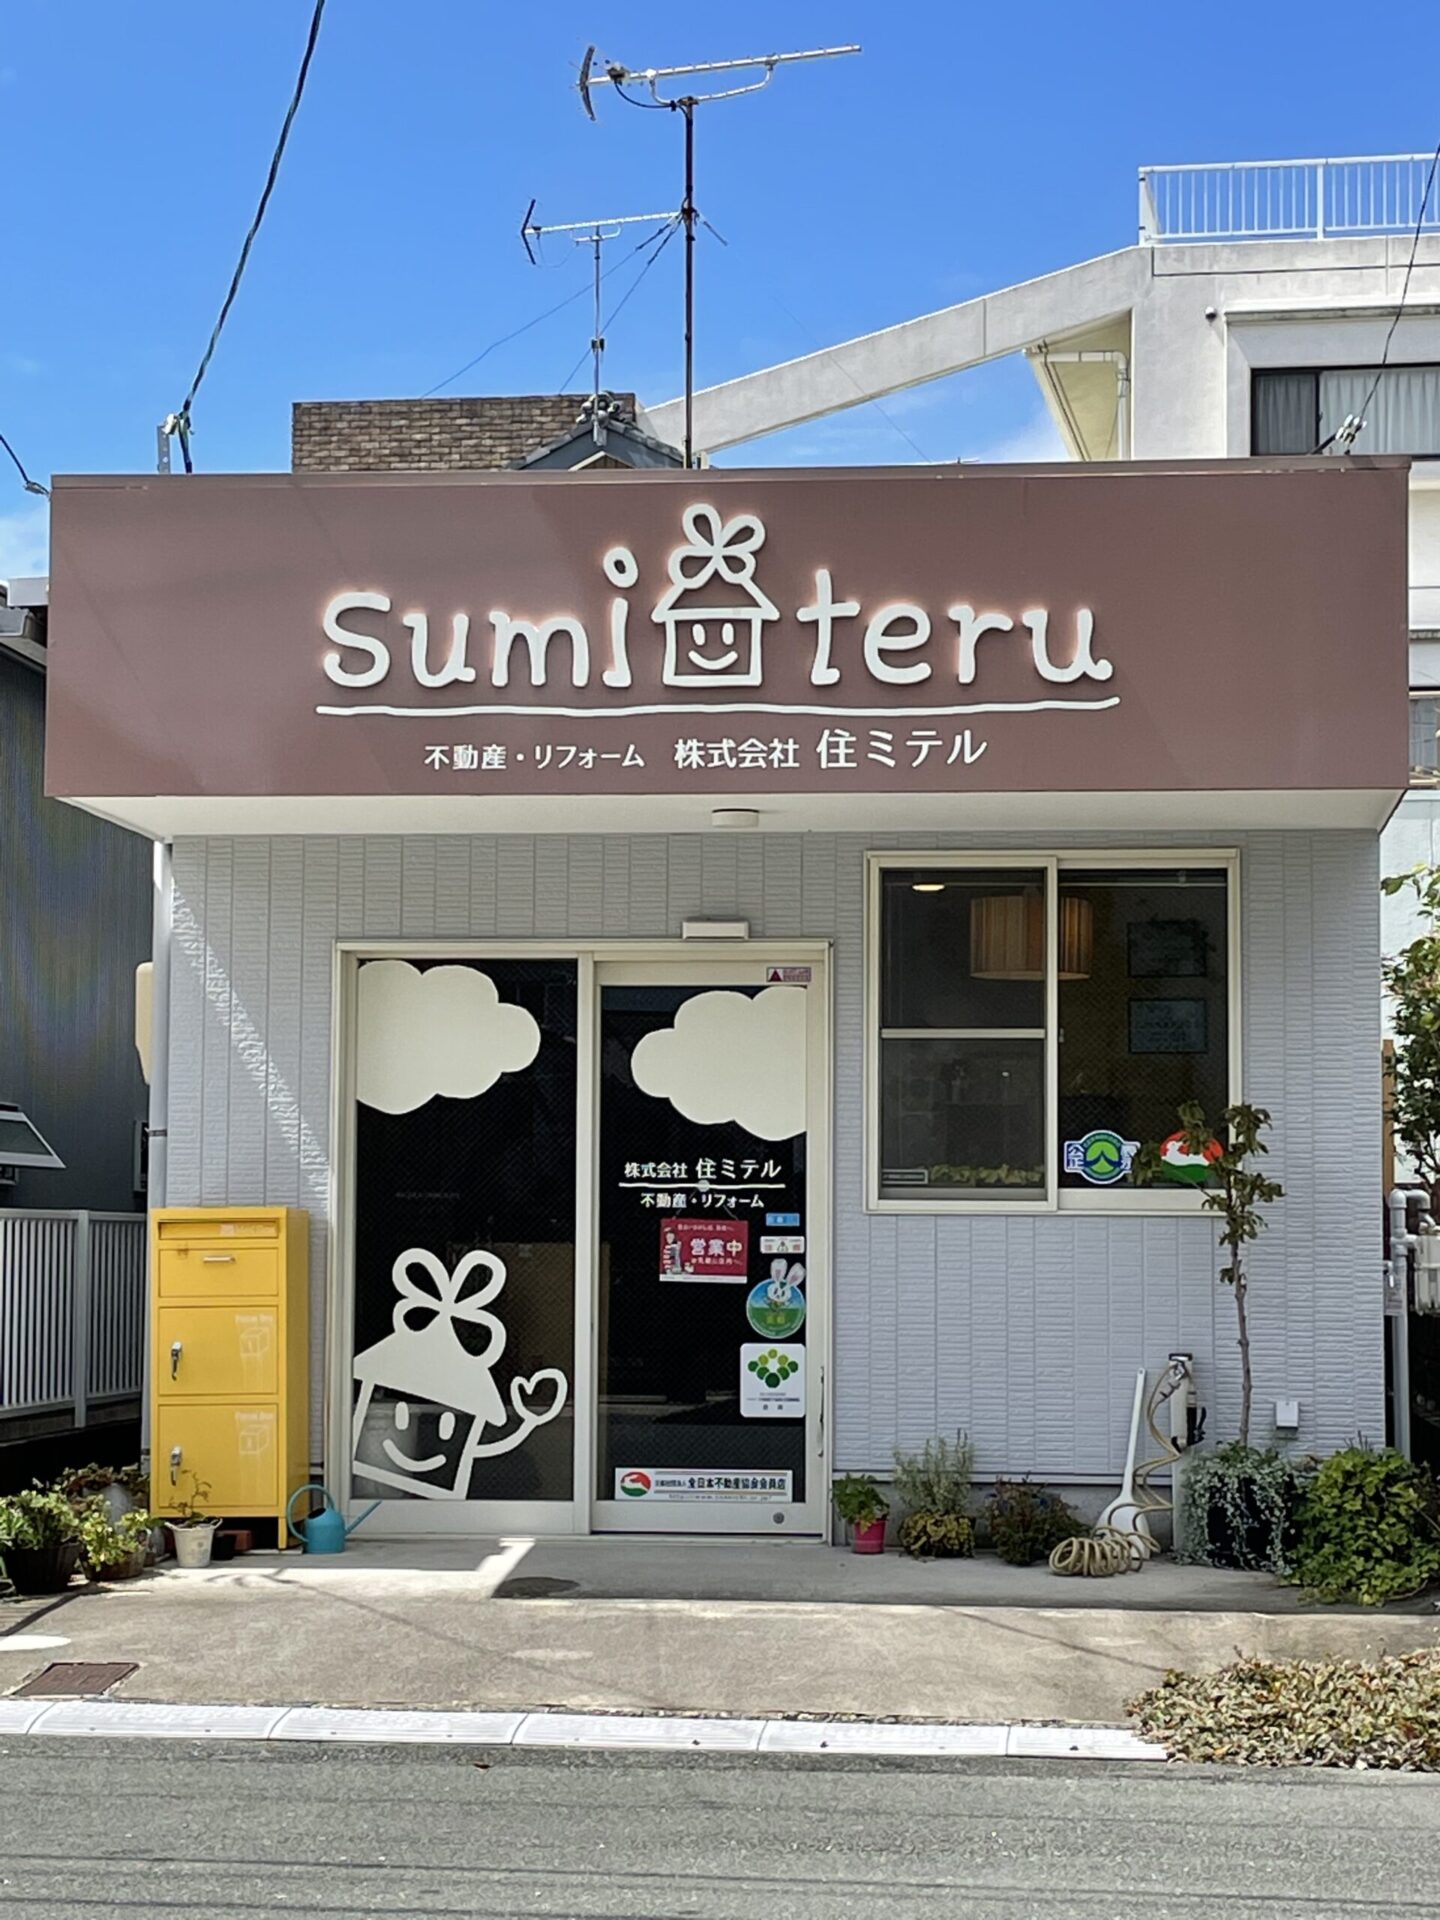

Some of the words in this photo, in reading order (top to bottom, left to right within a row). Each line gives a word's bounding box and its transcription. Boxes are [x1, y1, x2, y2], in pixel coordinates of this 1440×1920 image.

[796, 567, 1114, 687] teru
[424, 743, 646, 771] 不動産・リフォーム
[674, 737, 800, 770] 株式会社
[816, 728, 988, 770] 住ミテル
[624, 1161, 689, 1179] 株式会社
[695, 1157, 782, 1180] 住ミテル
[640, 1193, 765, 1209] 不動産・リフォーム
[690, 1237, 743, 1256] 営業中
